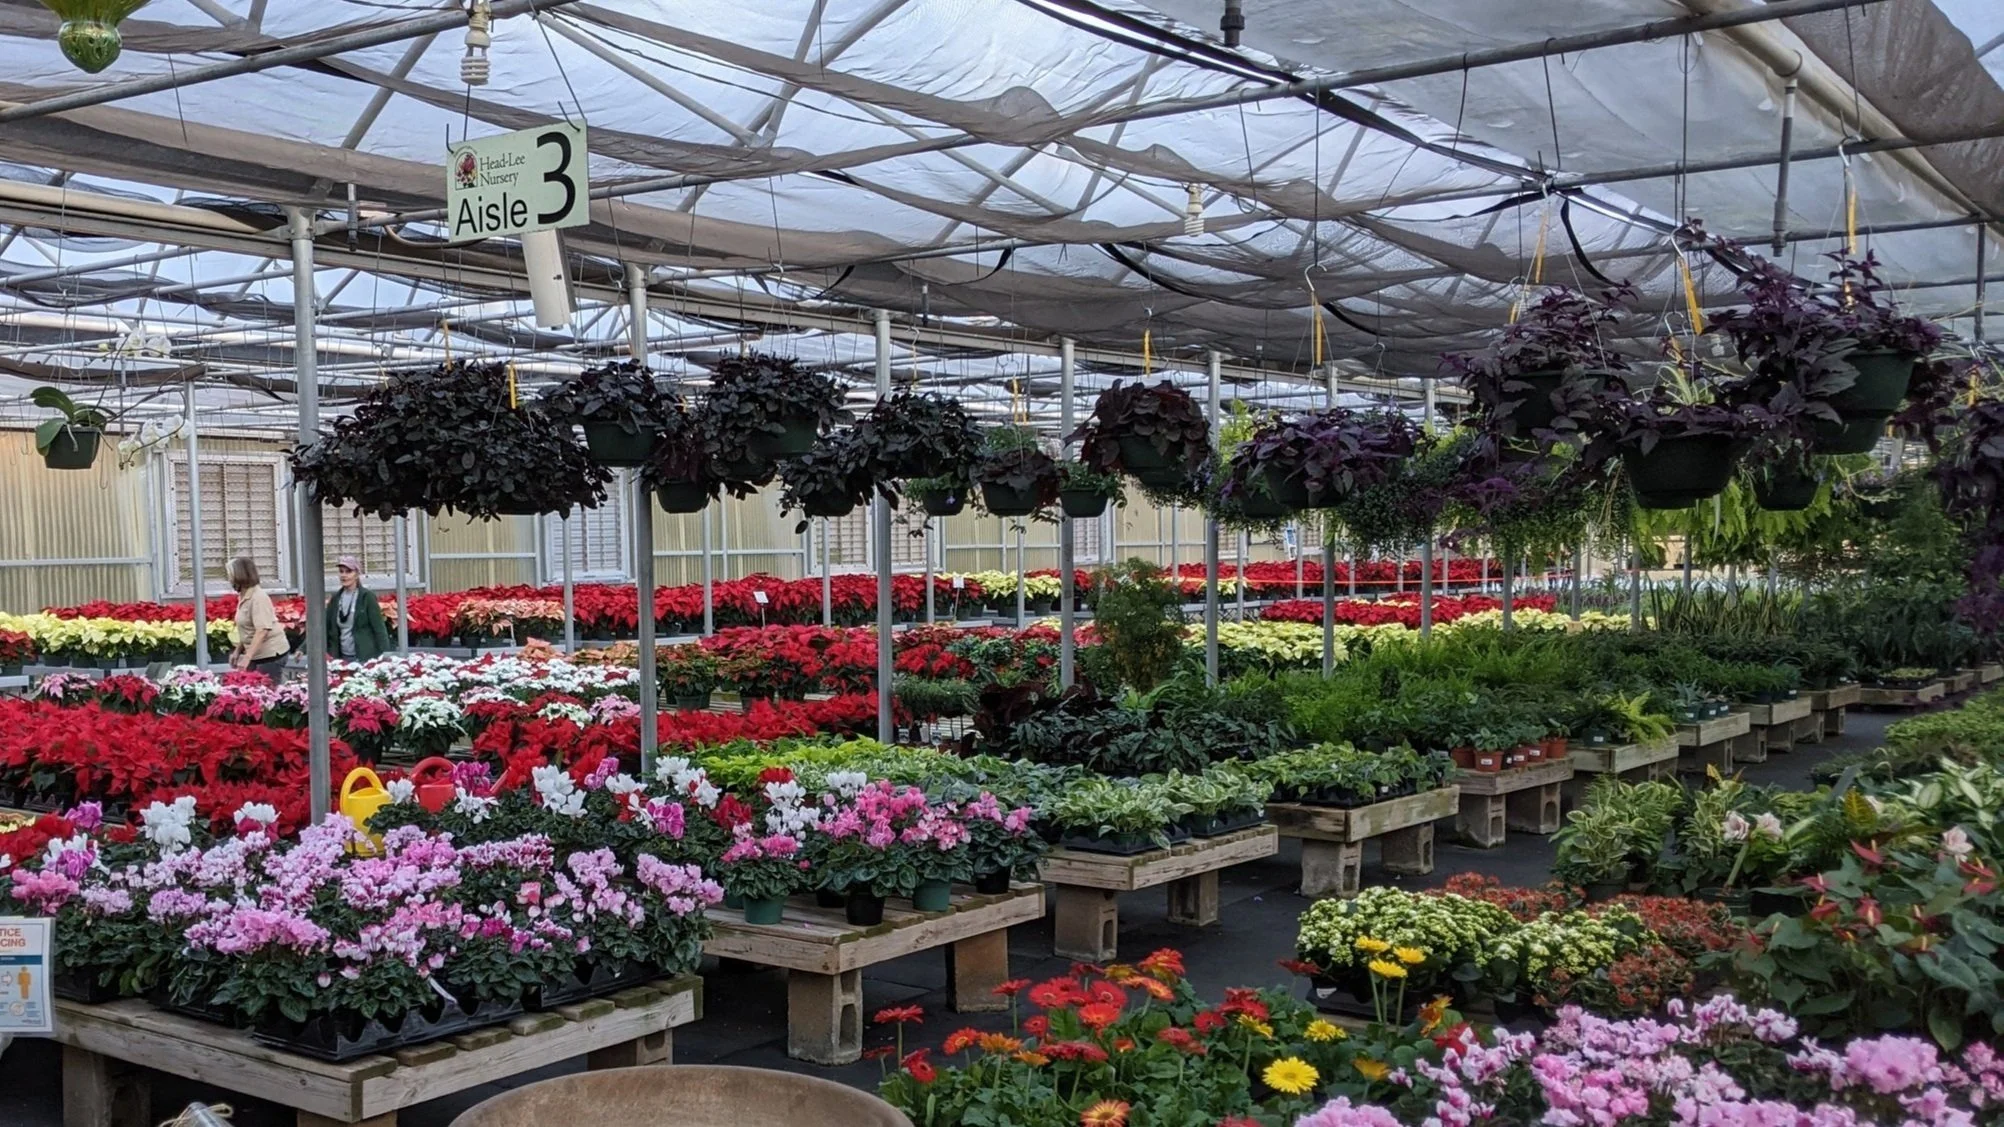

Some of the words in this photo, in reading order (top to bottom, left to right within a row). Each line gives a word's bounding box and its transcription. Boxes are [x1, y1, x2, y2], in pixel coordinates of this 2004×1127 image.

[480, 153, 526, 171] Head-Lee
[456, 192, 528, 236] Aisle
[537, 131, 576, 225] 3
[480, 172, 519, 187] Nursery
